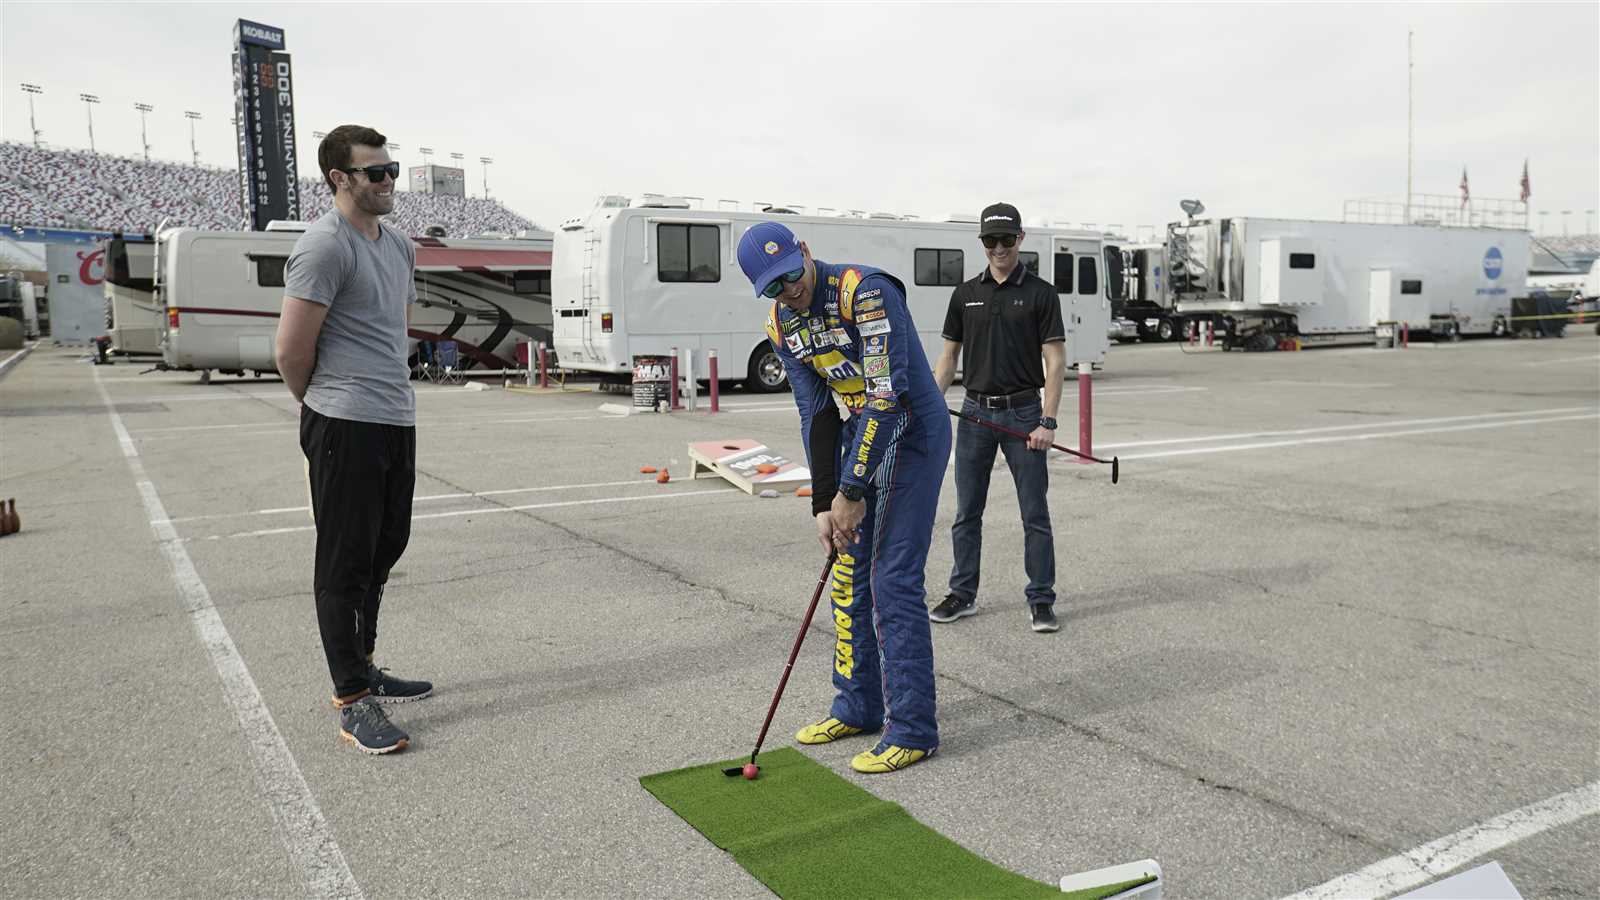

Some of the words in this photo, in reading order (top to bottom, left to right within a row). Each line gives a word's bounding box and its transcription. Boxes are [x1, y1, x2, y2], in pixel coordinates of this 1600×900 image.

[243, 25, 282, 43] KOBALT
[252, 63, 257, 72] 1
[252, 75, 258, 84] 2
[277, 62, 291, 106] 300
[282, 112, 297, 220] OYDGAMING
